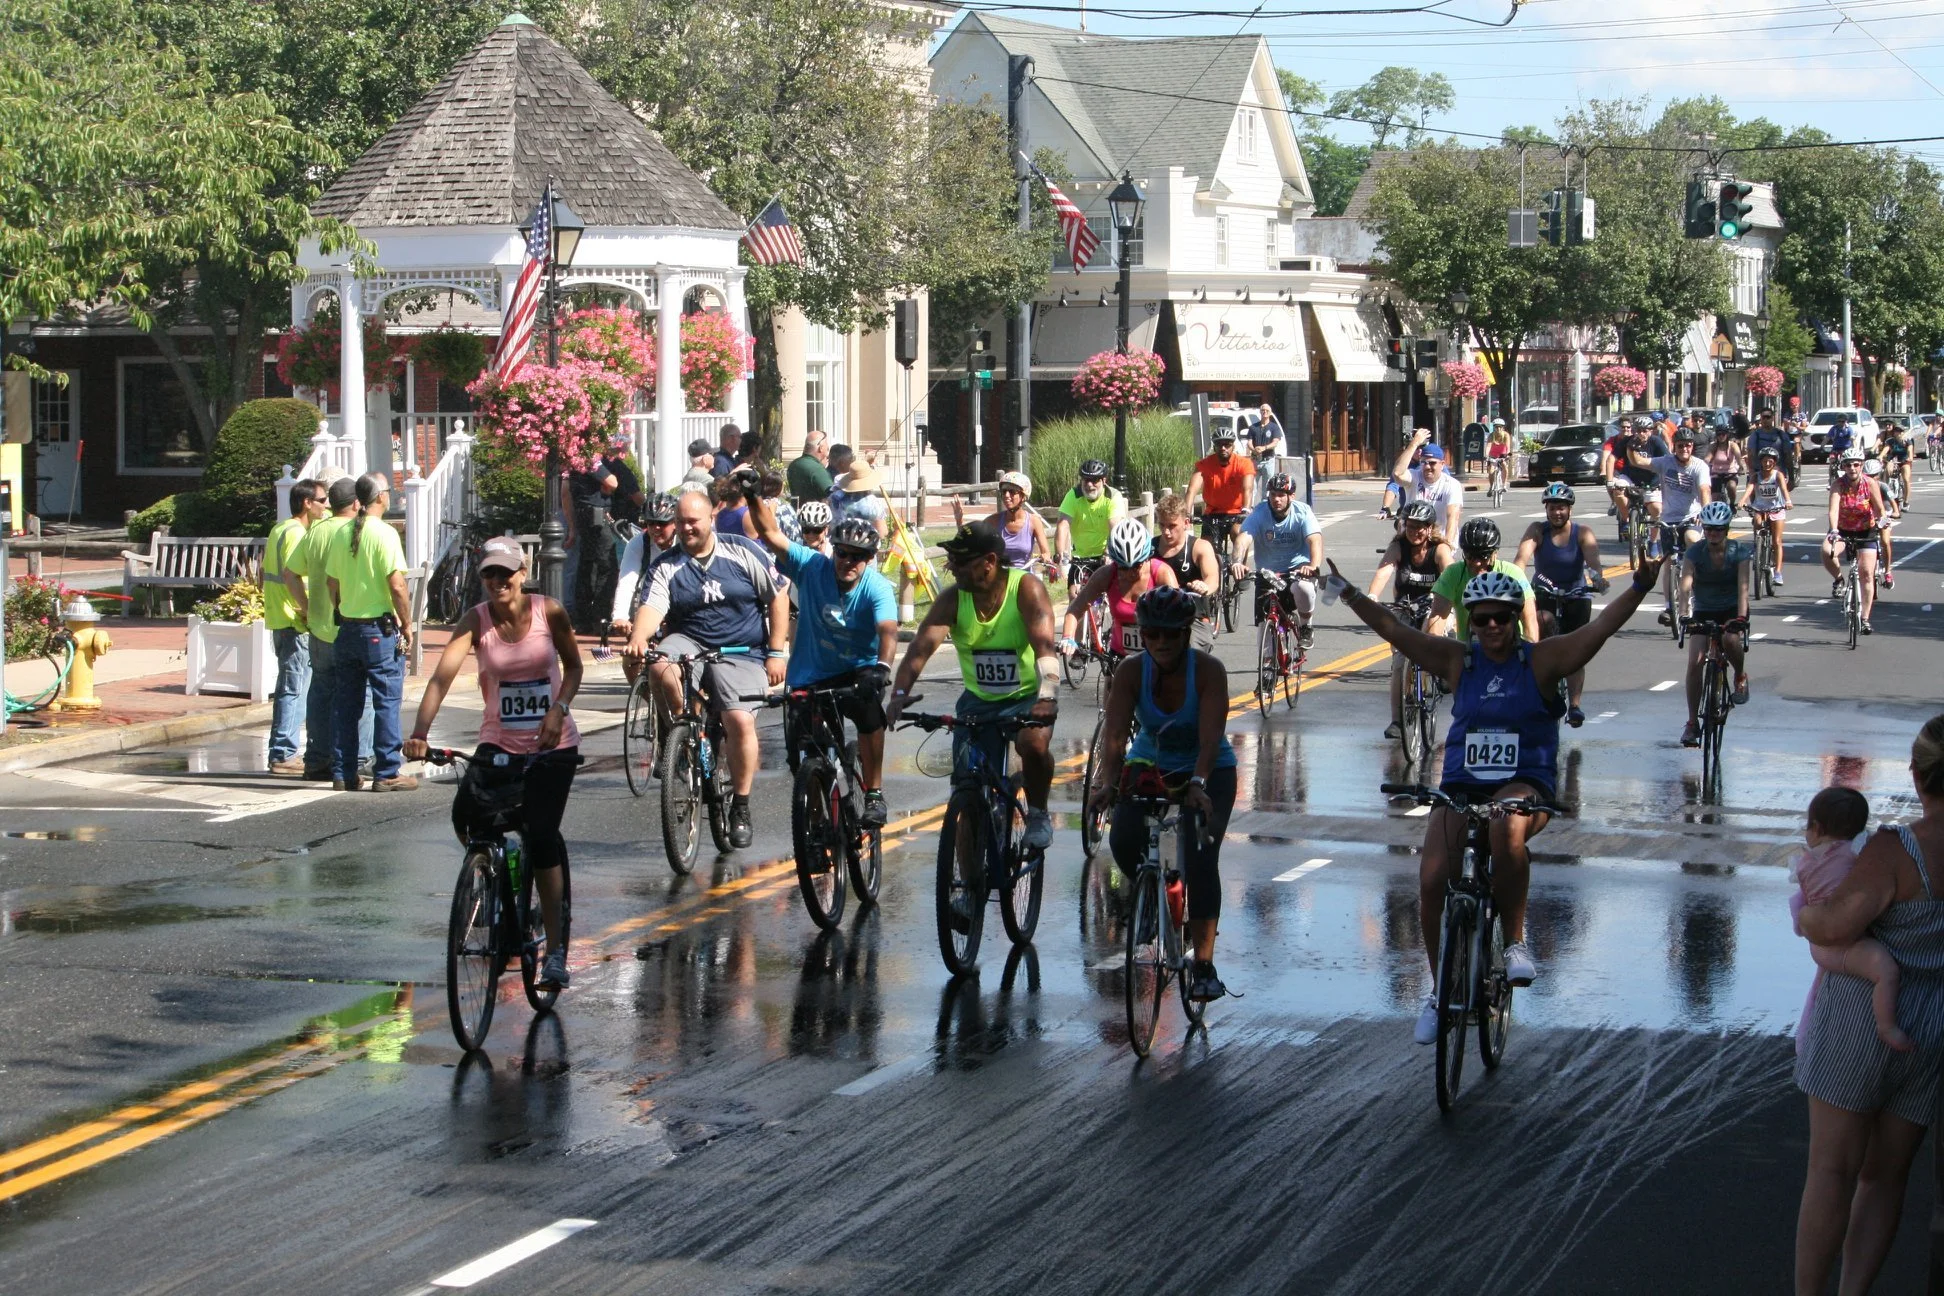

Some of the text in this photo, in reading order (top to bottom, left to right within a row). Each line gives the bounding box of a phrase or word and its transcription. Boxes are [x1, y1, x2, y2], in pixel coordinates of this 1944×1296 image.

[976, 663, 1016, 681] 0357
[502, 695, 551, 716] 0344
[1467, 744, 1516, 765] 0429
